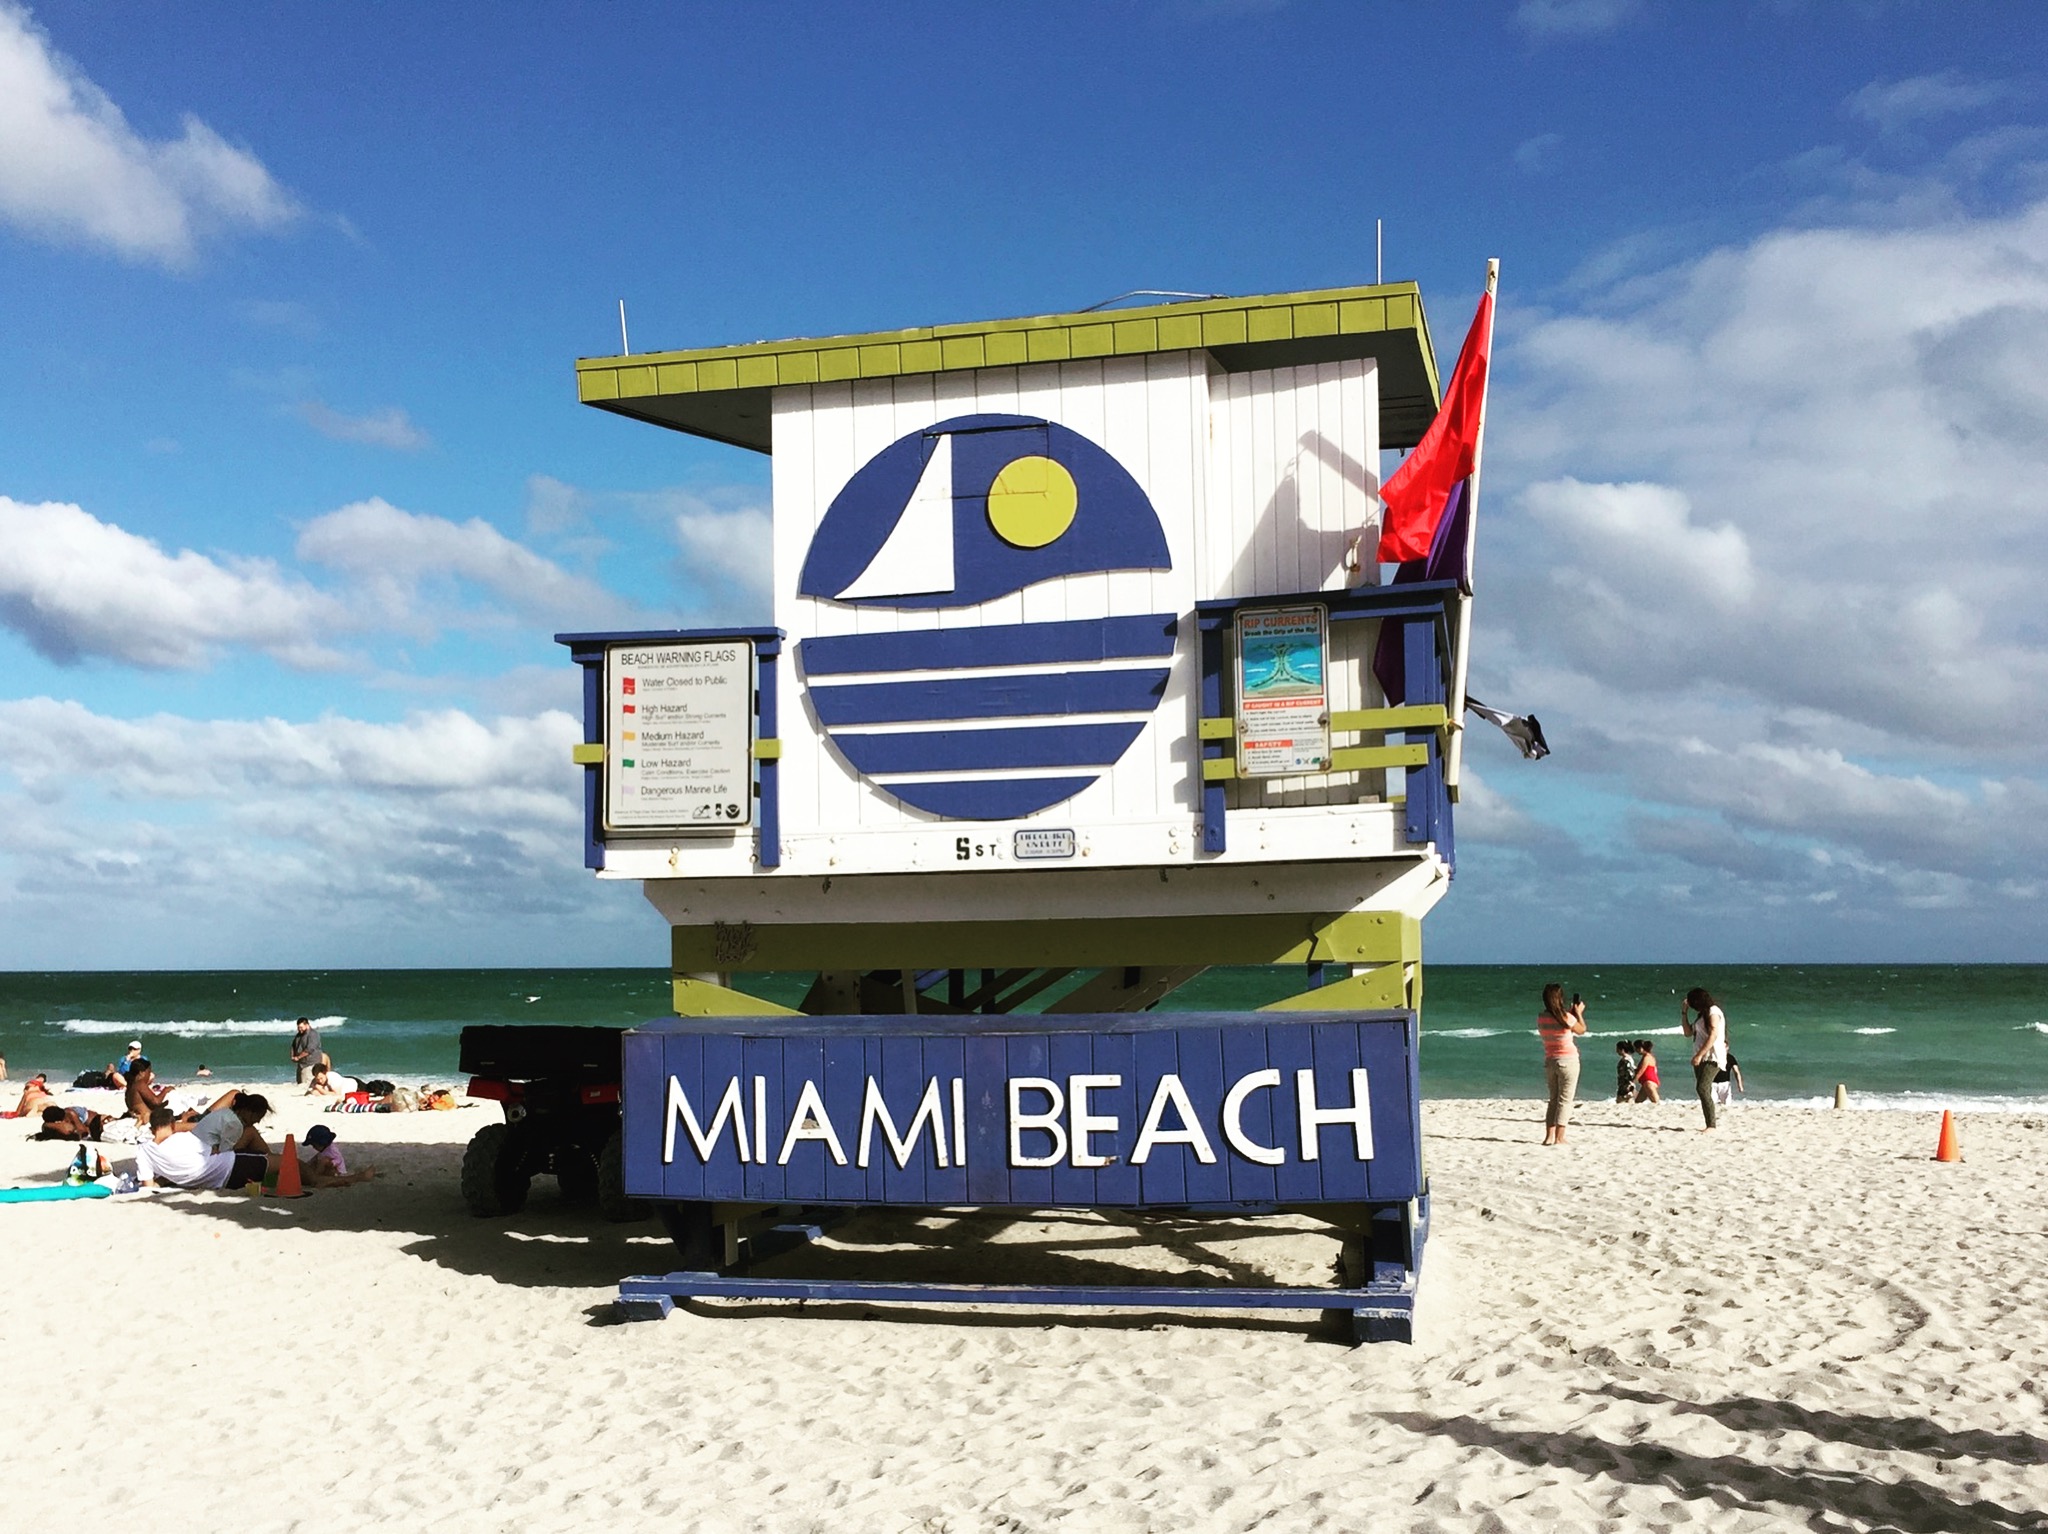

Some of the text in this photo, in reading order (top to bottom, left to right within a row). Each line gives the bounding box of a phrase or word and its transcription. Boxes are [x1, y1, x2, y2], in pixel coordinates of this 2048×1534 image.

[1244, 615, 1318, 628] RIP CURRENTS
[621, 649, 736, 665] BEACH WARNING FLAGS
[642, 675, 728, 687] Water Closed to Public
[641, 704, 687, 716] High Hazard
[641, 731, 704, 741] Medium Hazard
[641, 758, 691, 768] Low Hazard
[641, 783, 728, 797] Dangerous Marine Life
[975, 844, 997, 857] ST
[664, 1067, 1375, 1169] MIAMI BEACH
